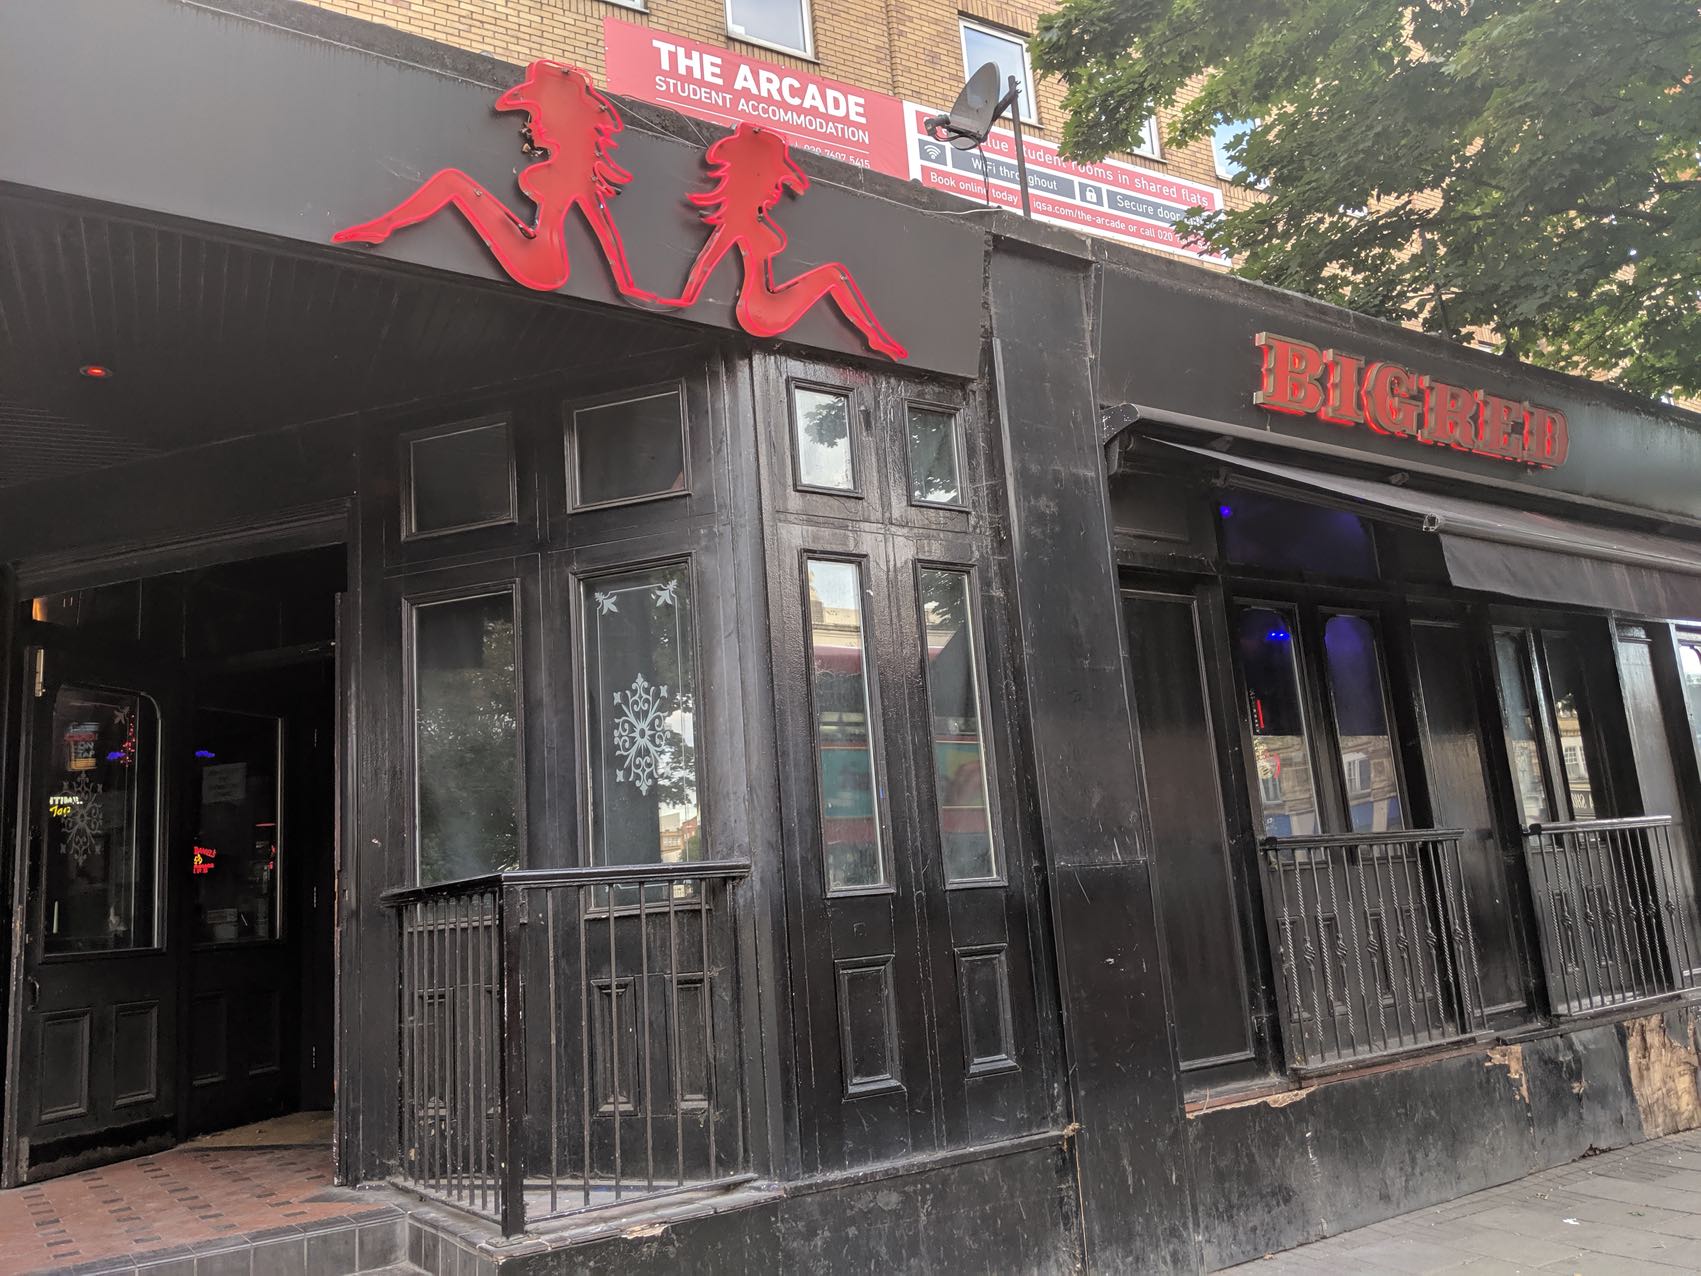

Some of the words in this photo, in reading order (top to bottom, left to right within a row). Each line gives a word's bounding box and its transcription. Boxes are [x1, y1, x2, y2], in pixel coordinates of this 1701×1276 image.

[652, 39, 723, 85] THE
[733, 64, 867, 124] ARCADE
[655, 75, 733, 108] STUDENT
[738, 98, 870, 144] ACCOMMODATION
[971, 157, 996, 174] WiFi
[999, 165, 1058, 191] throghout
[1022, 146, 1067, 168] tudent
[1117, 171, 1130, 185] in
[1134, 177, 1177, 198] shared
[1181, 189, 1208, 206] flats
[930, 171, 956, 187] Book
[959, 180, 987, 196] onlin
[991, 188, 1018, 205] today
[1033, 198, 1126, 229] iqsa.com/the-arcade
[1127, 224, 1137, 233] or
[1139, 226, 1155, 238] call
[1157, 230, 1173, 242] 020
[1116, 195, 1154, 215] Secure
[1157, 205, 1181, 221] door
